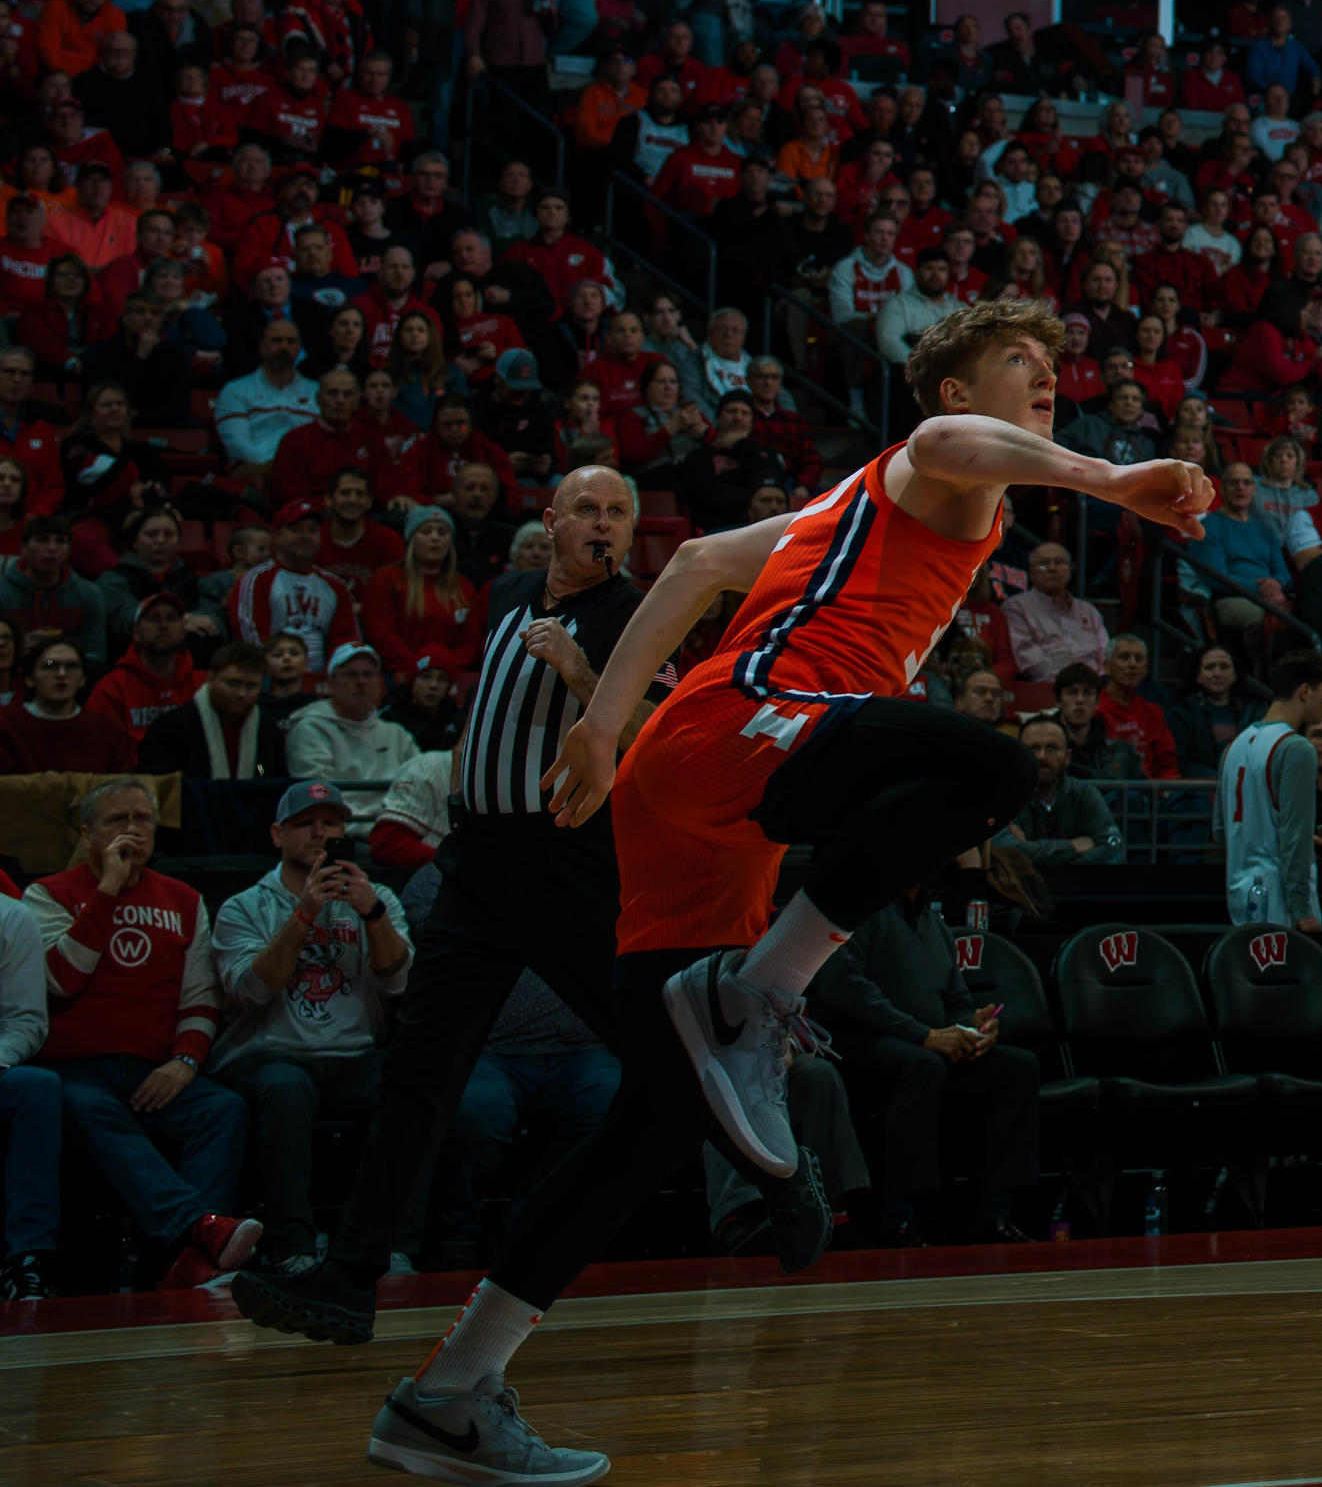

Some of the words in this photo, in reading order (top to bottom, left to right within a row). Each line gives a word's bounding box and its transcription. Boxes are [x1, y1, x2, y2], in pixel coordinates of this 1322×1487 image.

[1233, 766, 1246, 823] 1
[1099, 931, 1139, 973] W
[1250, 931, 1288, 972] W
